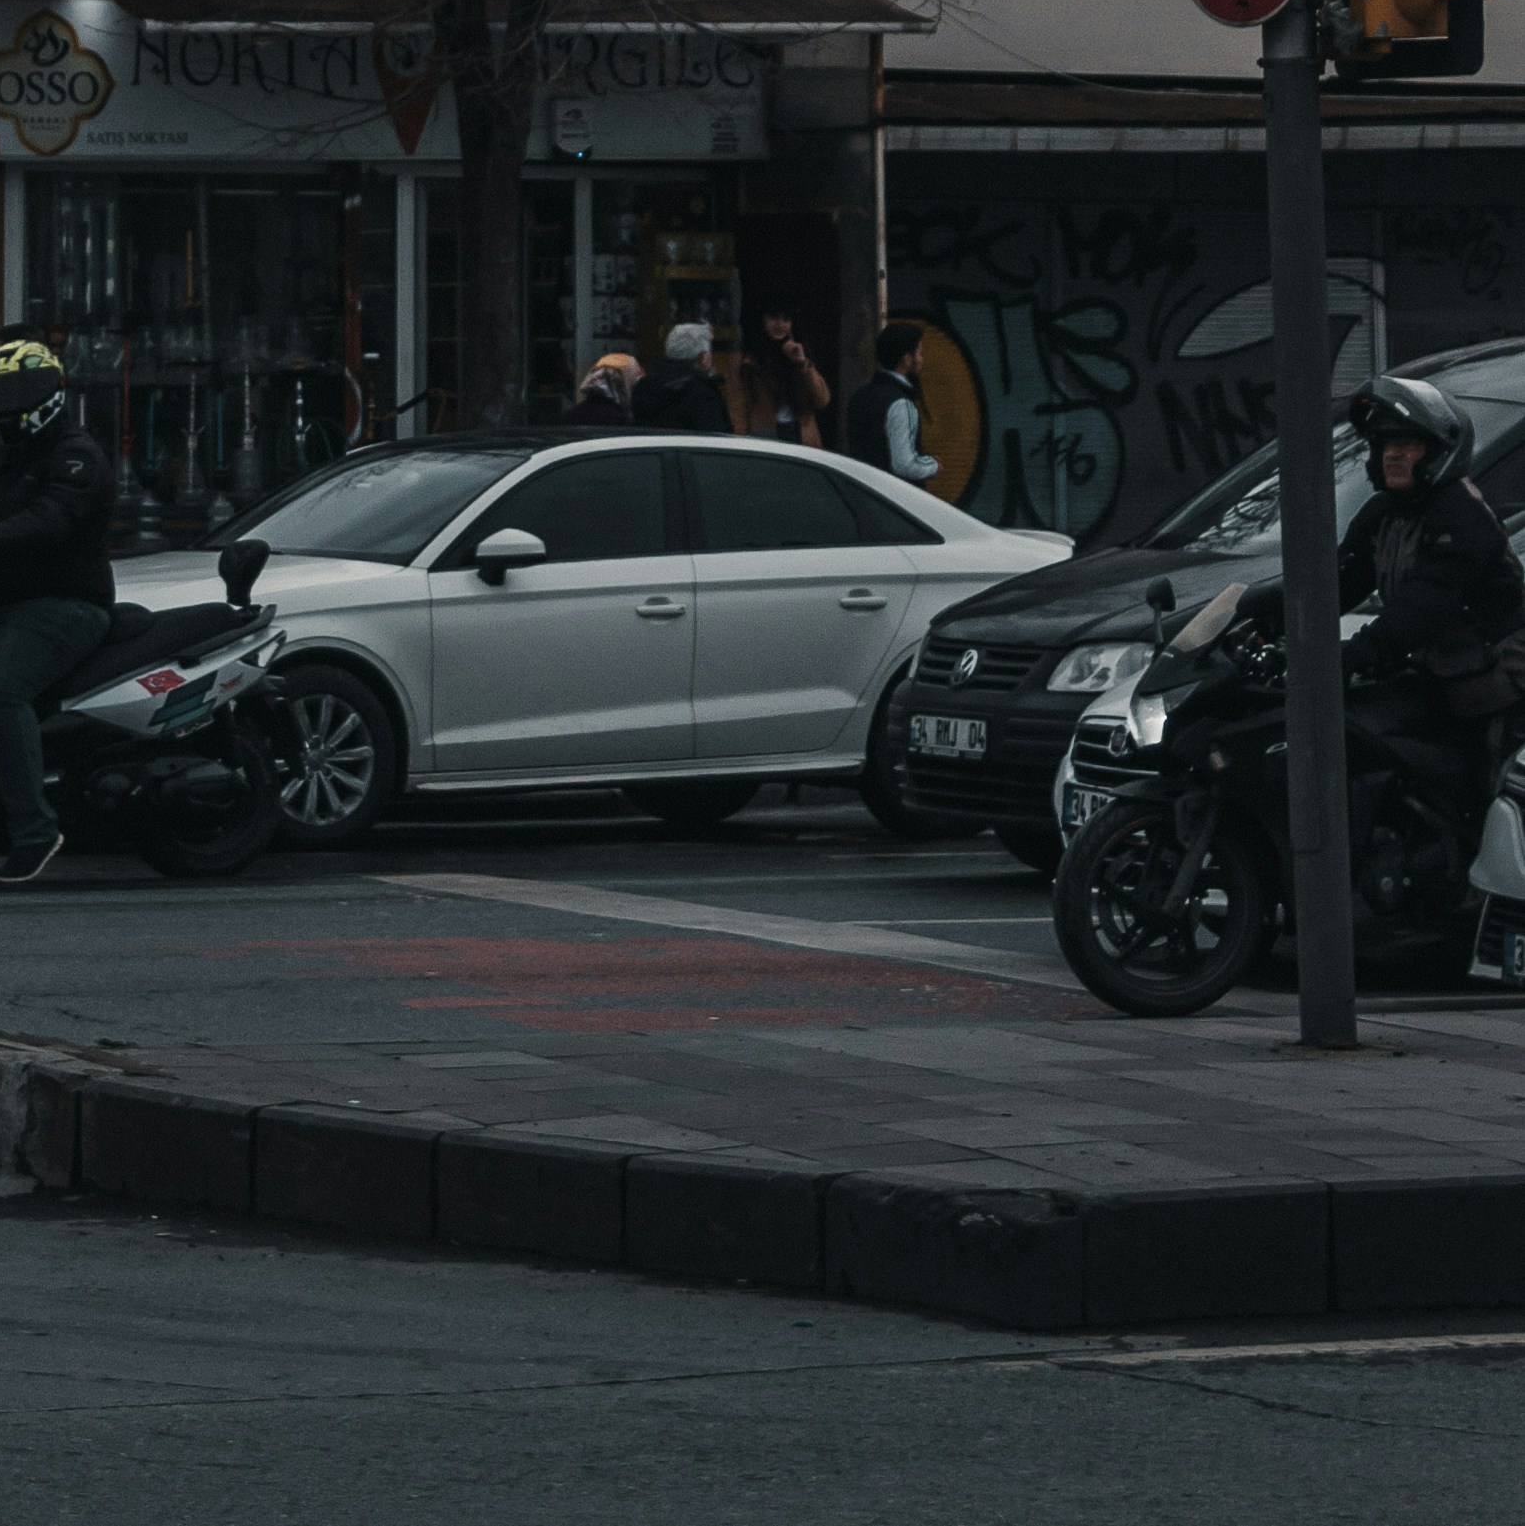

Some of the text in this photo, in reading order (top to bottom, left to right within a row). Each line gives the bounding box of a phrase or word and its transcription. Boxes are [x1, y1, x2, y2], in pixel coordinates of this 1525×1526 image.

[132, 27, 362, 95] NOKTA
[86, 130, 125, 148] SATIŞ
[915, 717, 928, 744] 34
[1072, 791, 1087, 822] 34
